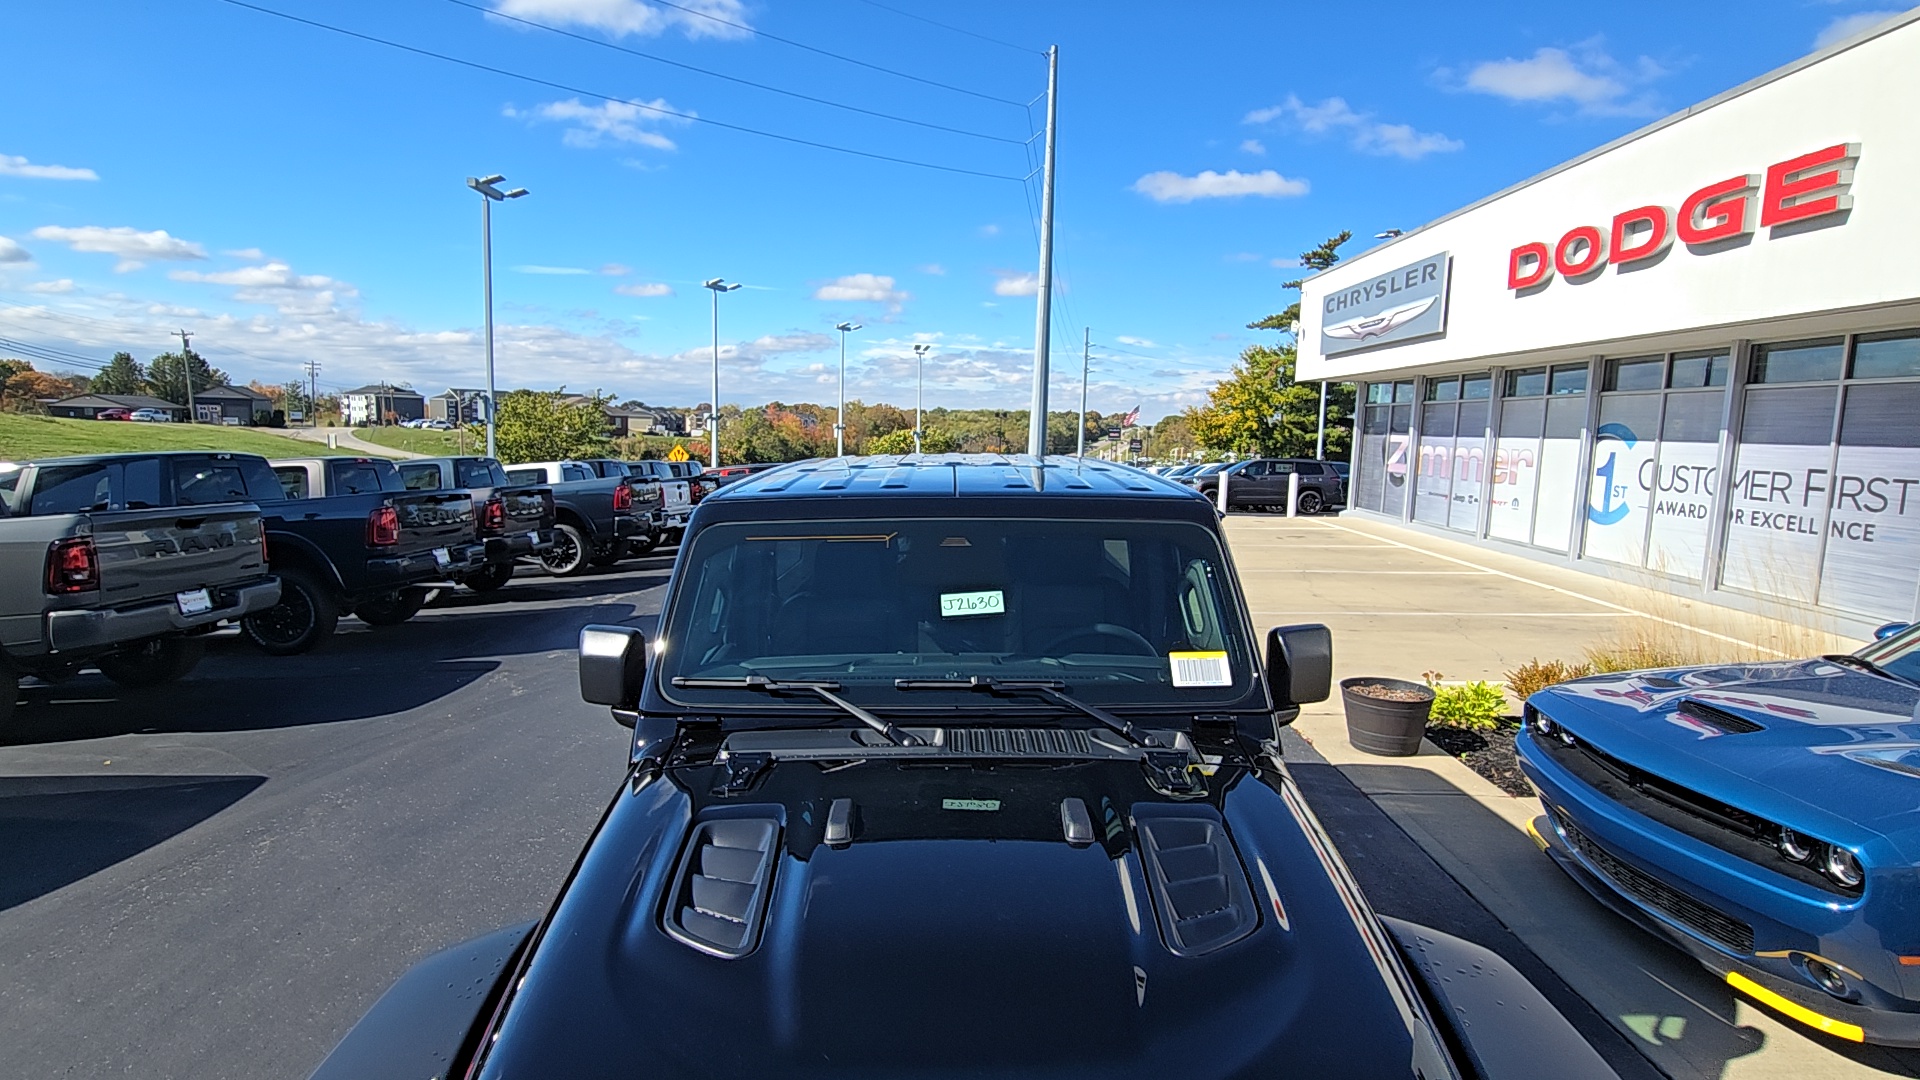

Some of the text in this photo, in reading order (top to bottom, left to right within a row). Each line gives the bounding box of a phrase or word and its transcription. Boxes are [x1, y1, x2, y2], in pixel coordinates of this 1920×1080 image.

[1508, 143, 1860, 289] DODGE
[1325, 263, 1437, 313] CHRYSLER
[1388, 434, 1533, 485] Zmmer
[1803, 469, 1919, 515] FIRST
[417, 508, 462, 524] RAM
[1655, 500, 1708, 519] AWARD
[1750, 511, 1876, 542] EXCELLNCE
[147, 532, 235, 557] RAM
[943, 595, 999, 611] J2630
